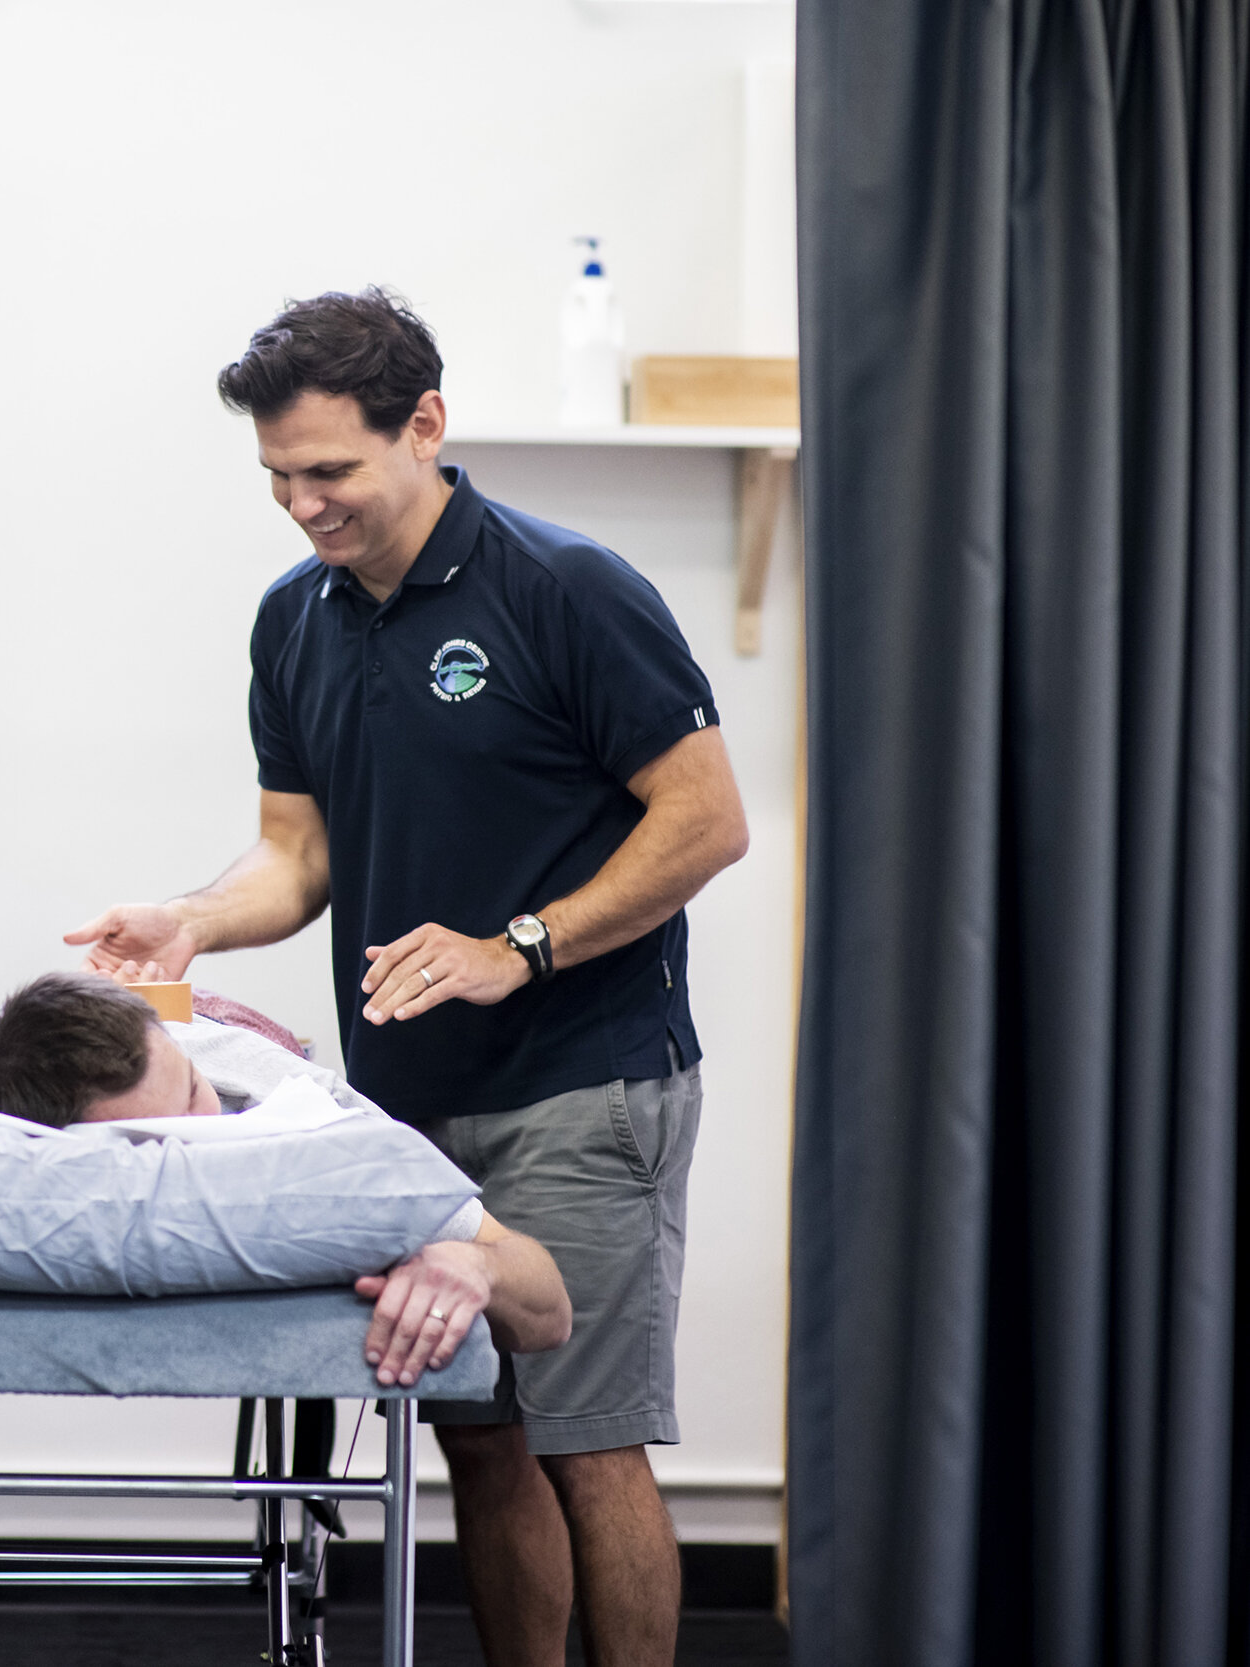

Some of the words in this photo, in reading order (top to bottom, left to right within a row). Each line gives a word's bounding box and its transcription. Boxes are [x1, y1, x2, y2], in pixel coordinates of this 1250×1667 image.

[442, 639, 466, 651] JONES
[466, 641, 489, 667] CENTRE
[430, 682, 452, 702] PHYSIO
[462, 678, 486, 699] REHAB
